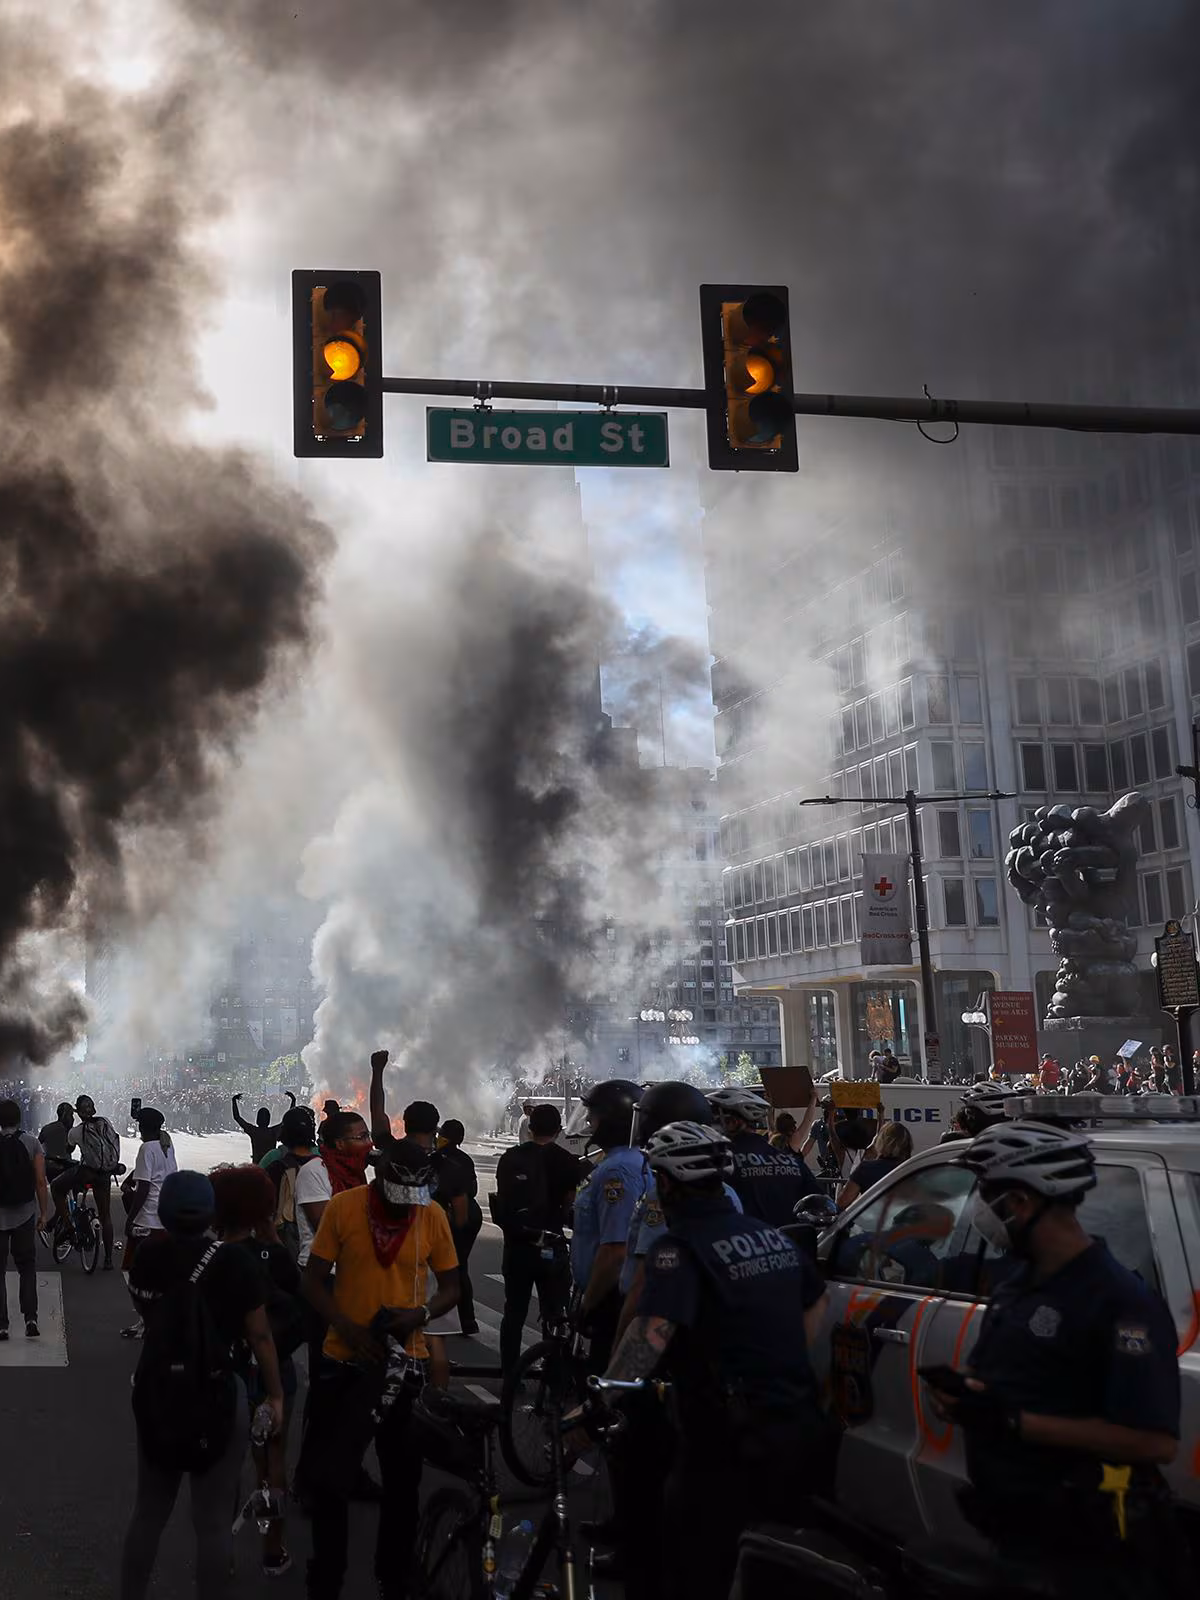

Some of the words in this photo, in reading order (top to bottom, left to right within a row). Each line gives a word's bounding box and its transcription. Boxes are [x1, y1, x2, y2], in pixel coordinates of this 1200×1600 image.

[450, 418, 574, 451] Broad
[600, 422, 645, 452] St
[735, 1152, 799, 1167] POLICE
[740, 1165, 774, 1178] STRIKE
[711, 1229, 792, 1264] POLICE
[728, 1259, 768, 1281] STRIKE
[769, 1250, 799, 1272] FORCE
